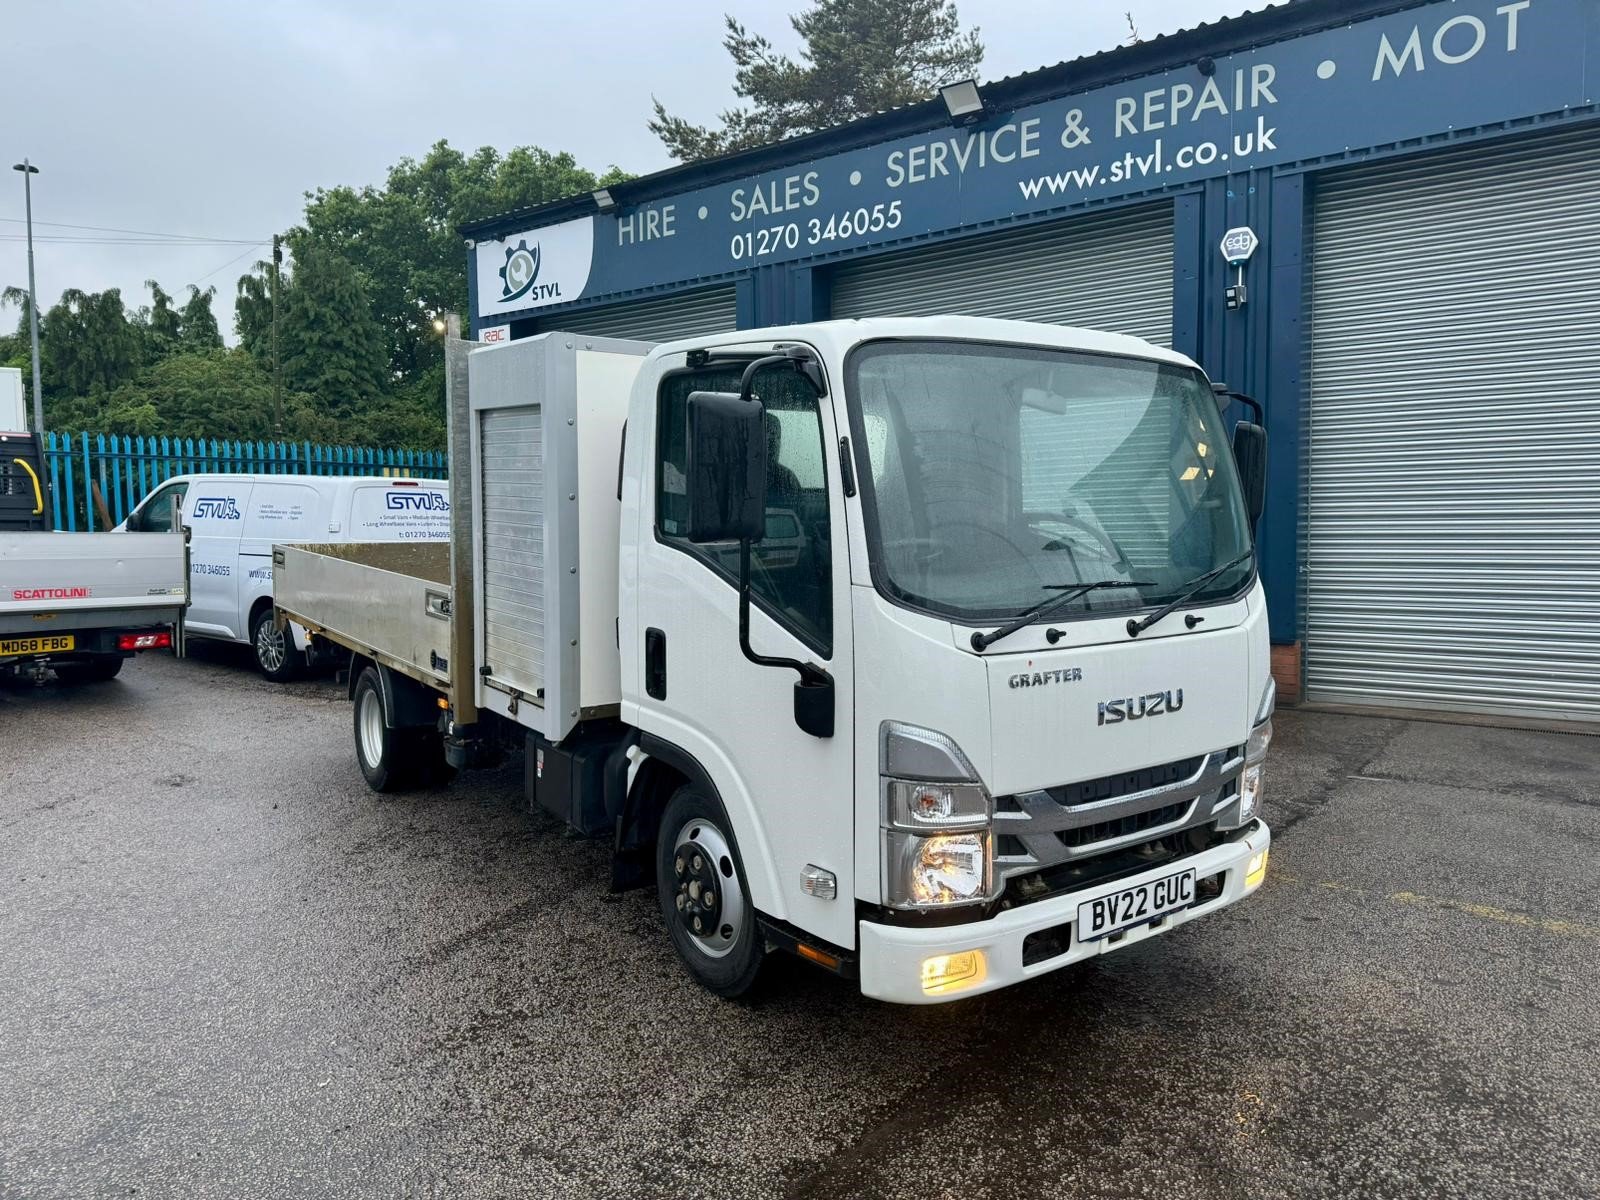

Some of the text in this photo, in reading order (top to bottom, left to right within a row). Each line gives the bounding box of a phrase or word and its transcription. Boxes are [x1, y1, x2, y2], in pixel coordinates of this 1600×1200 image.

[617, 1, 1531, 247] HIRE SALES SERVICE & REPAIR MOT
[1018, 115, 1278, 201] www.stvl.co.uk
[730, 200, 903, 260] 01270 346055
[531, 282, 563, 302] STVL
[207, 565, 230, 576] 346055
[14, 588, 88, 599] SCATTOLINI
[42, 638, 68, 650] FBG
[1009, 668, 1082, 689] GRAFTER
[1097, 688, 1183, 726] ISUZU
[1092, 873, 1191, 932] BV22 GUC
